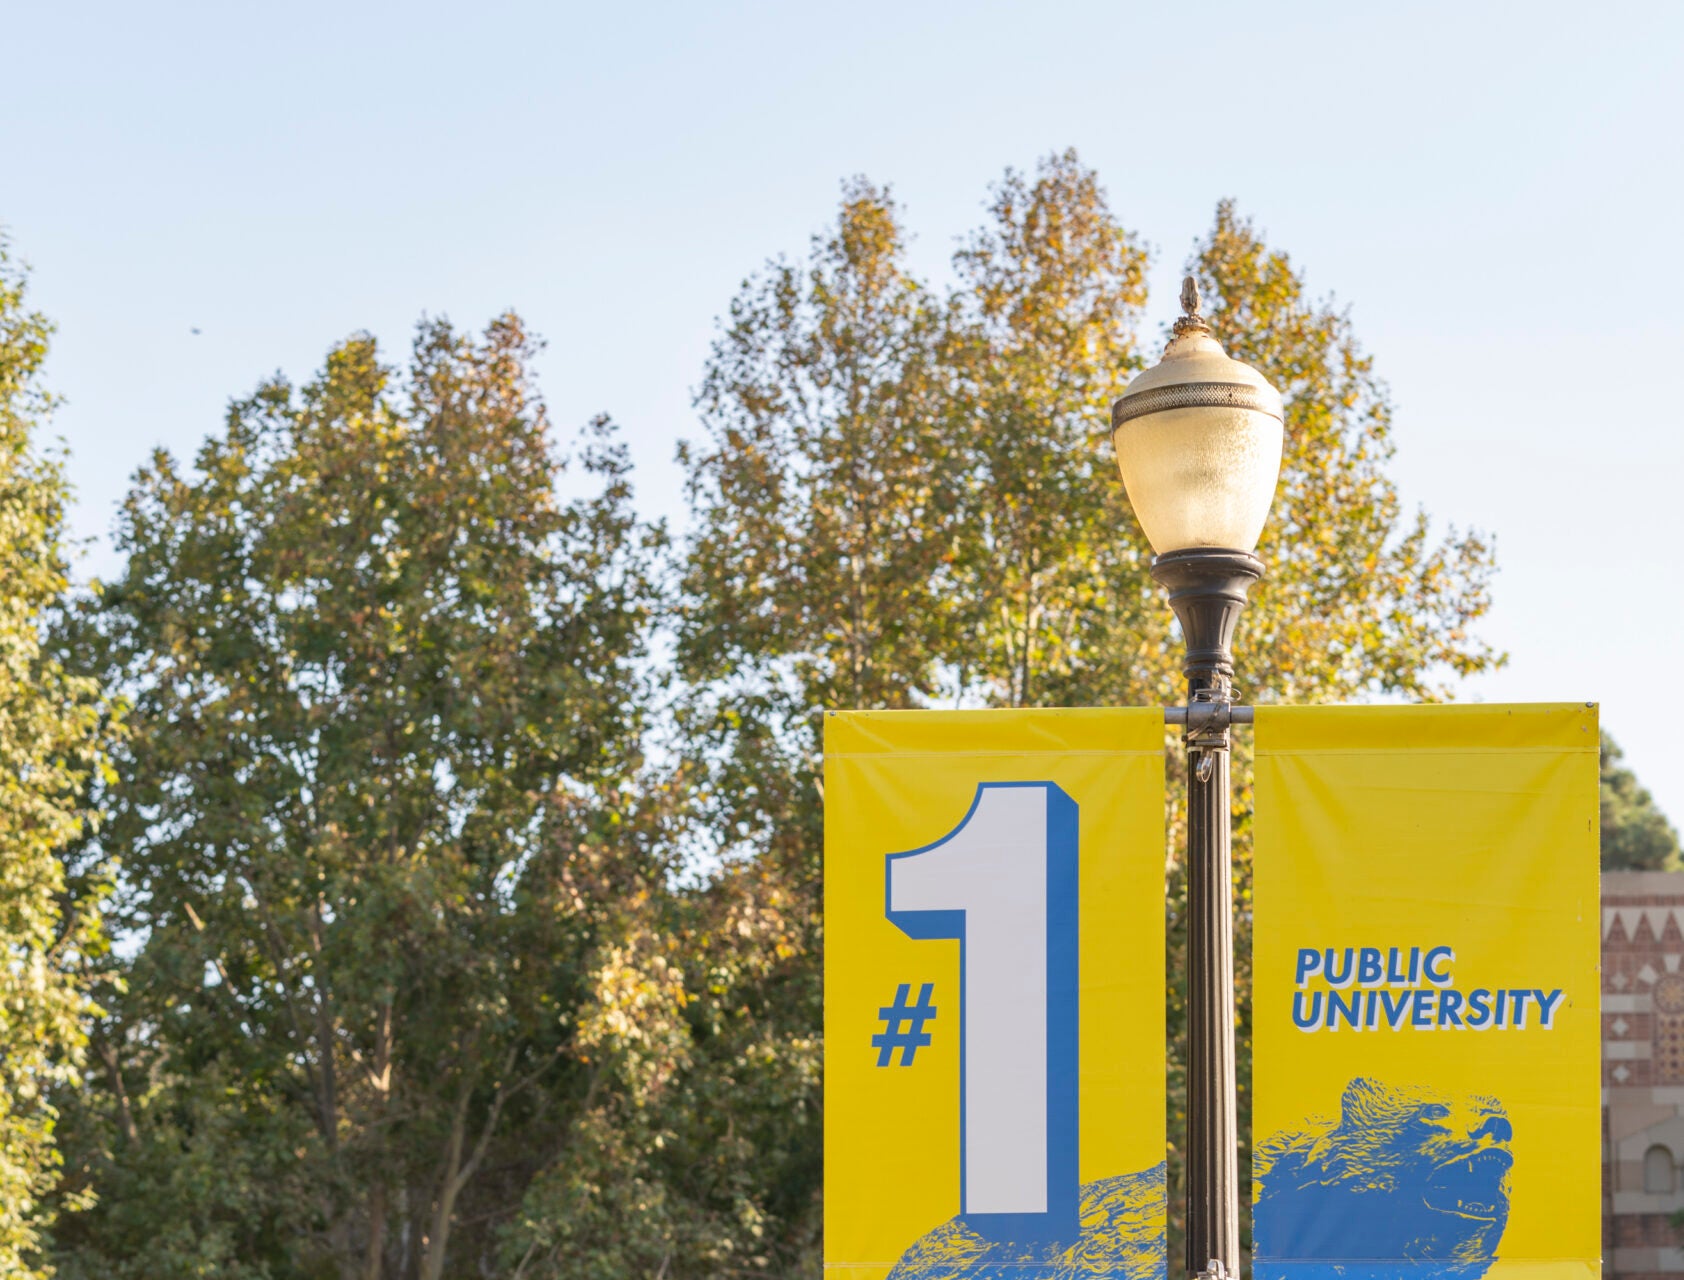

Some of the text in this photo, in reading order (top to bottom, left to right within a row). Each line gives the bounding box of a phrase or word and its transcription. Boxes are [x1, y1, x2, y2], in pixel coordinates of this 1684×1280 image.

[1295, 945, 1456, 988] PUBLIC
[871, 780, 1080, 1238] #1
[1292, 988, 1567, 1033] UNIVERSITY
